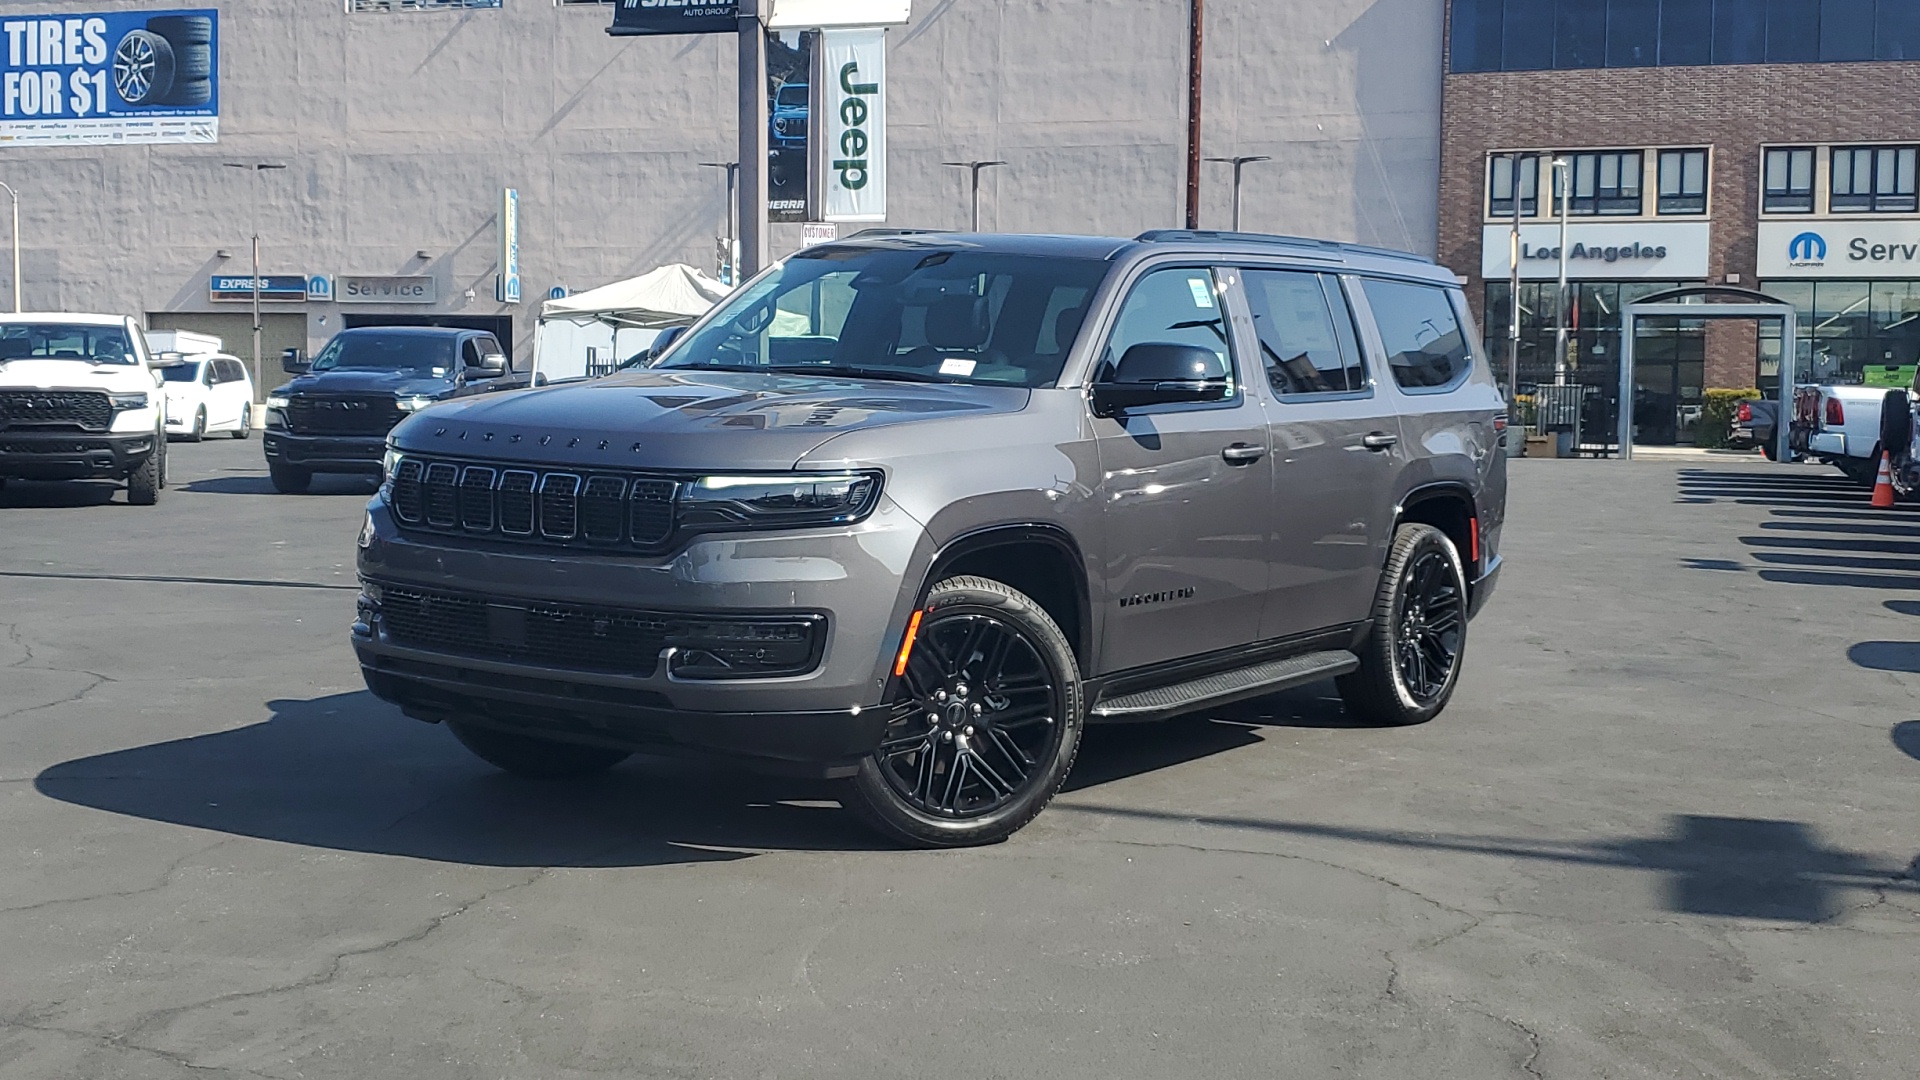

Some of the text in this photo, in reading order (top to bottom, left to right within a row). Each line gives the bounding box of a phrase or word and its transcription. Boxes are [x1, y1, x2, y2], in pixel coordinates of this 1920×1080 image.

[683, 8, 704, 16] AUTO
[4, 17, 107, 66] TIRES
[4, 66, 107, 117] FOR $1
[833, 61, 879, 191] Jeep
[768, 199, 806, 210] IERRA
[803, 226, 835, 239] CUSTOMER
[1522, 241, 1667, 263] Los Angeles
[1848, 237, 1919, 261] Serv
[347, 282, 424, 296] Service
